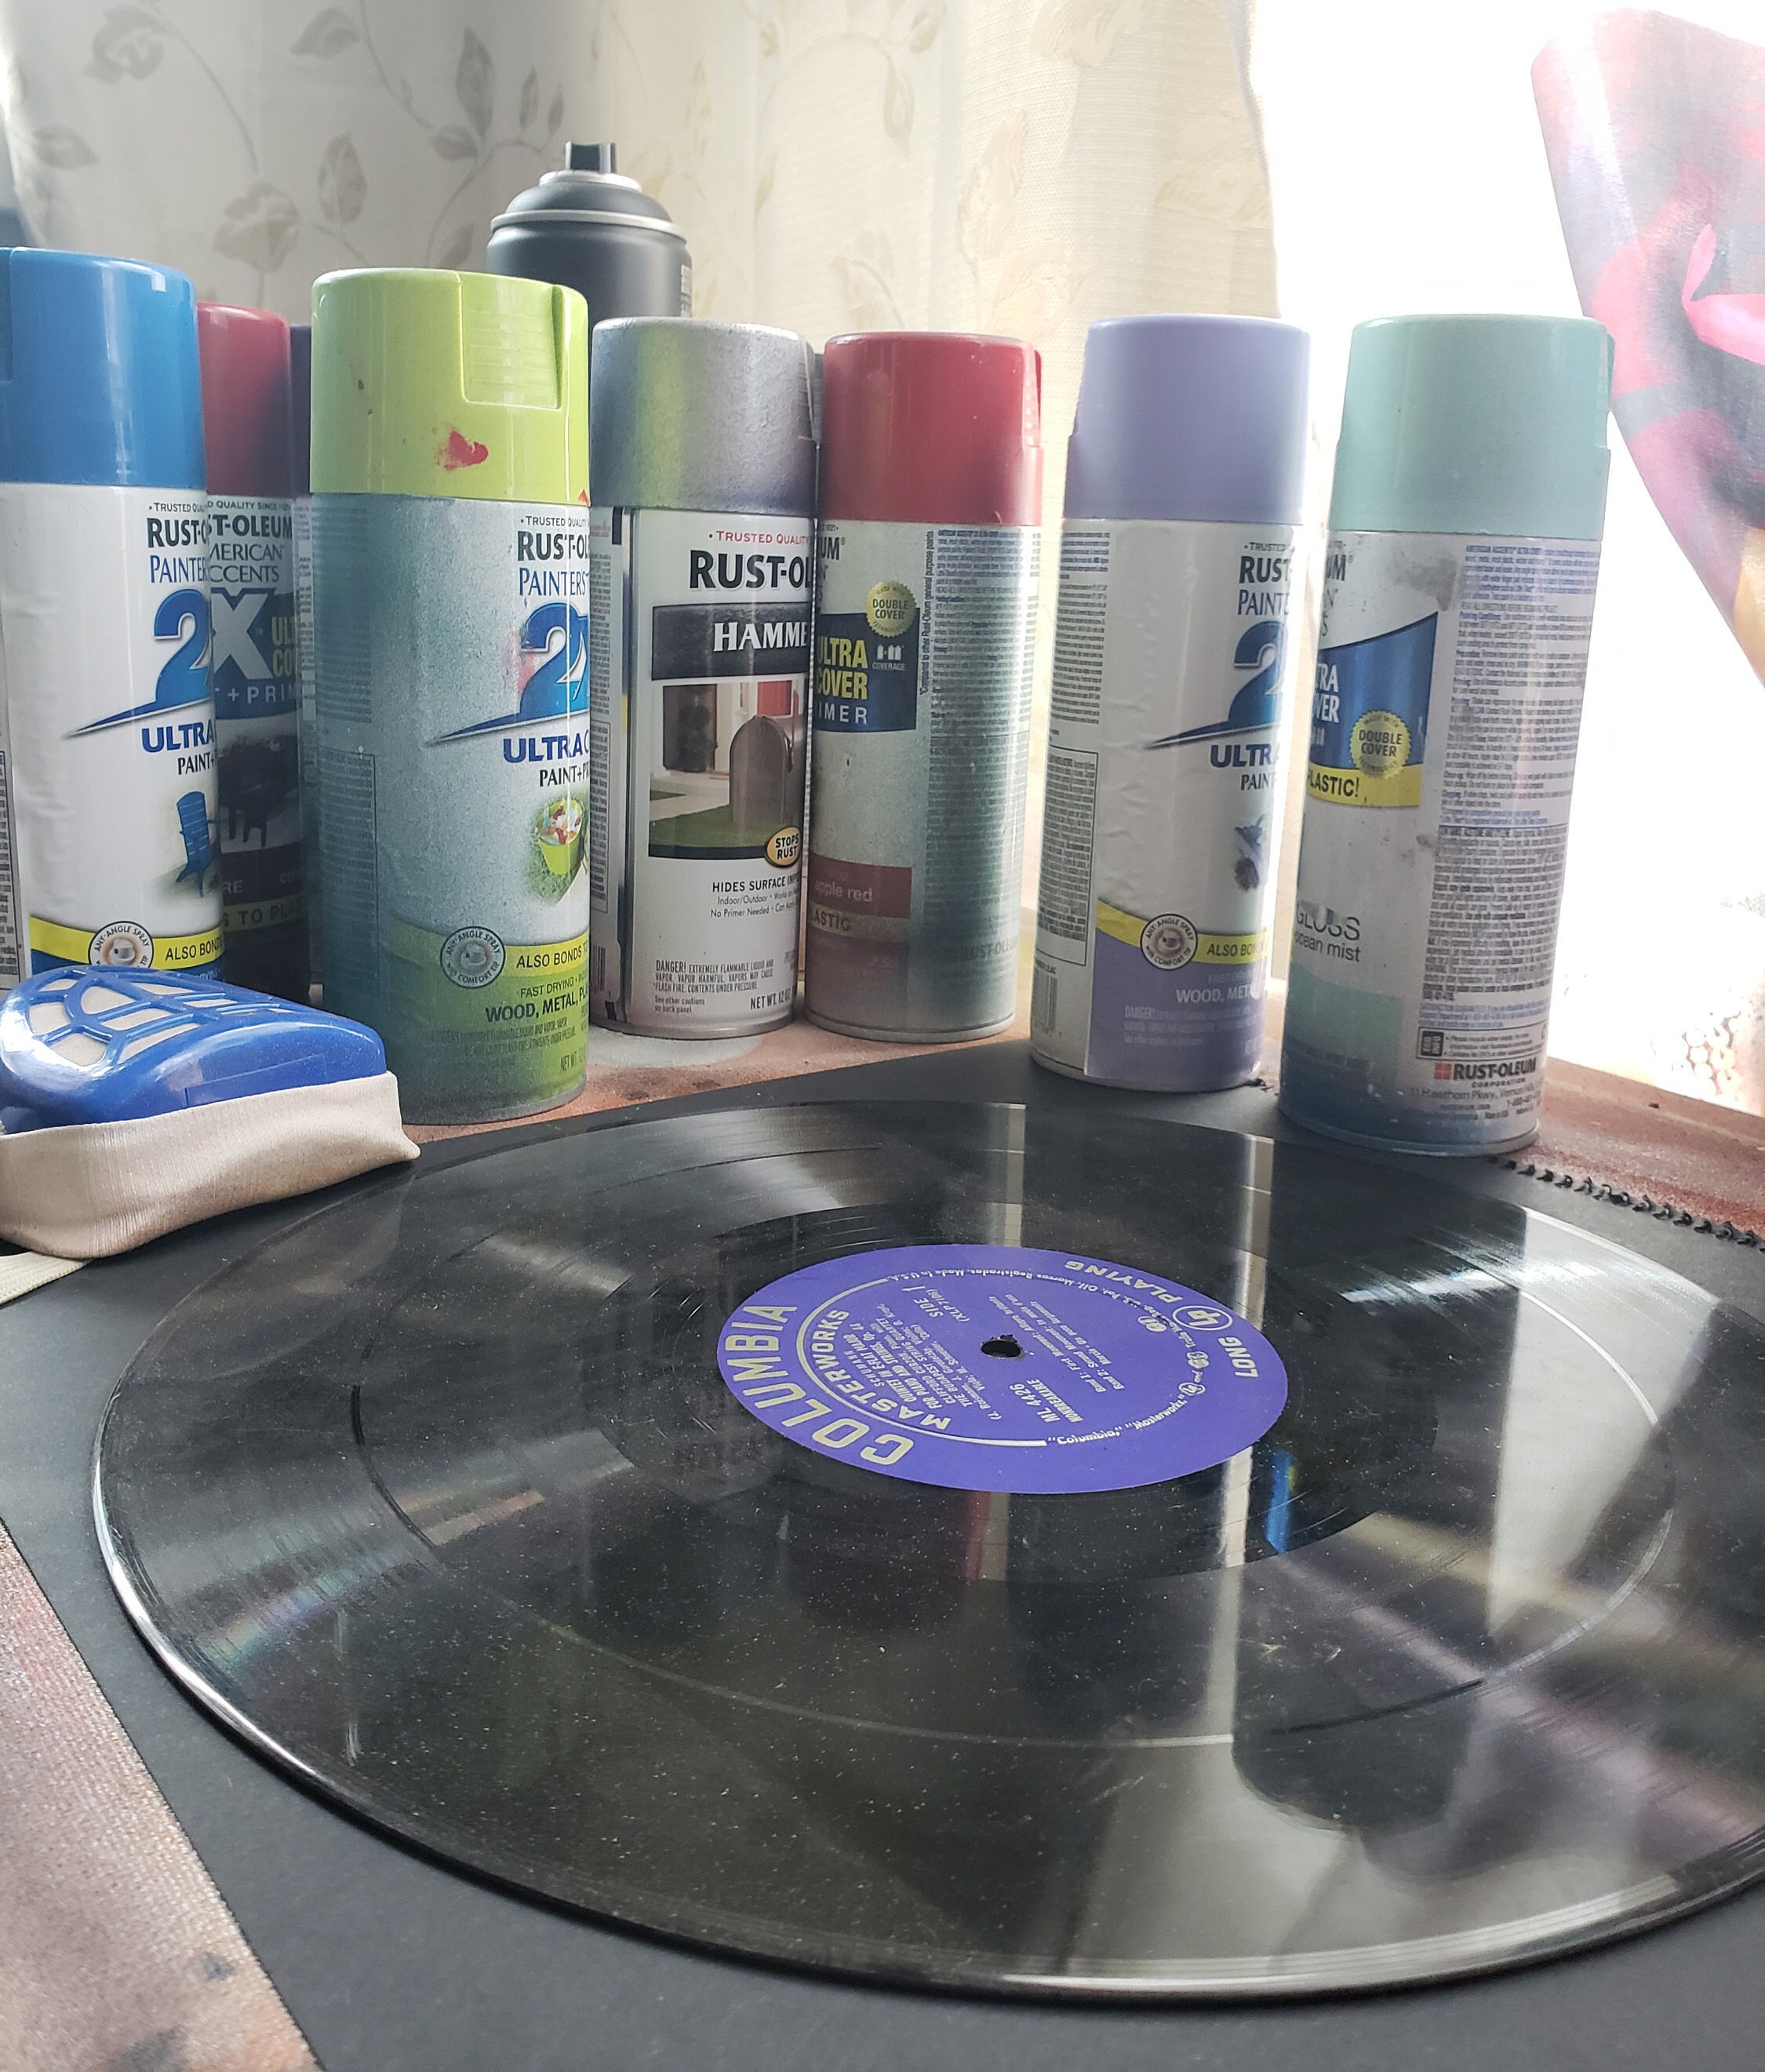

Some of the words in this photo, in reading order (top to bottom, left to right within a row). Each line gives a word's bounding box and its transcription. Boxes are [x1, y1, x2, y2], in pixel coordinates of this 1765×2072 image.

[154, 502, 191, 513] TRUSTED
[525, 515, 566, 527] TRUSTED
[715, 530, 773, 543] TRUSTED
[872, 598, 909, 610] DOUBLE
[875, 609, 905, 620] COVER
[872, 661, 906, 671] COVERAGE
[1359, 729, 1403, 745] DOUBLE
[1361, 743, 1397, 757] COVER
[775, 833, 799, 849] STOPS
[777, 846, 798, 860] RUST
[712, 881, 746, 893] HIDES
[748, 876, 786, 892] SURFACE
[847, 887, 873, 903] red
[710, 908, 722, 918] No
[723, 908, 745, 918] Primer
[747, 905, 770, 916] Needed
[133, 928, 151, 947] SPRAY
[484, 933, 501, 954] SPRAY
[165, 945, 196, 961] ALSO
[516, 954, 551, 969] ALSO
[554, 945, 583, 965] BONDS
[1206, 943, 1238, 957] ALSO
[1326, 942, 1361, 962] mist
[656, 959, 687, 973] DANGER!
[689, 963, 719, 974] EXTREMELY
[677, 972, 696, 983] VAPOR
[520, 984, 545, 998] FAST
[546, 976, 575, 994] DRYING
[687, 983, 715, 994] CONTENTS
[485, 1002, 540, 1023] WOOD,
[542, 991, 579, 1016] METAL,
[750, 995, 766, 1010] NET
[1454, 1056, 1538, 1081] RUST-OLEUM
[1064, 1260, 1185, 1305] PLAYING
[913, 1297, 944, 1318] SIDE
[875, 1318, 905, 1341] QUARTET
[901, 1341, 928, 1362] STRING
[1217, 1336, 1259, 1379] LONG
[811, 1309, 952, 1430] MASTERWORKS
[843, 1350, 892, 1387] SCHUMANN
[891, 1365, 912, 1377] AND
[725, 1306, 915, 1465] COLUMBIA
[922, 1363, 959, 1393] BUDAPEST
[1085, 1379, 1107, 1393] Band
[1102, 1376, 1125, 1390] Band
[885, 1378, 918, 1403] QUINTET
[903, 1377, 930, 1396] PIANO
[921, 1375, 961, 1405] CLIFFORD
[1009, 1383, 1043, 1406] 4426
[922, 1396, 943, 1409] FOR
[953, 1392, 973, 1408] THE
[1026, 1379, 1084, 1423] NONBREAKABLE
[1036, 1407, 1061, 1423] ML
